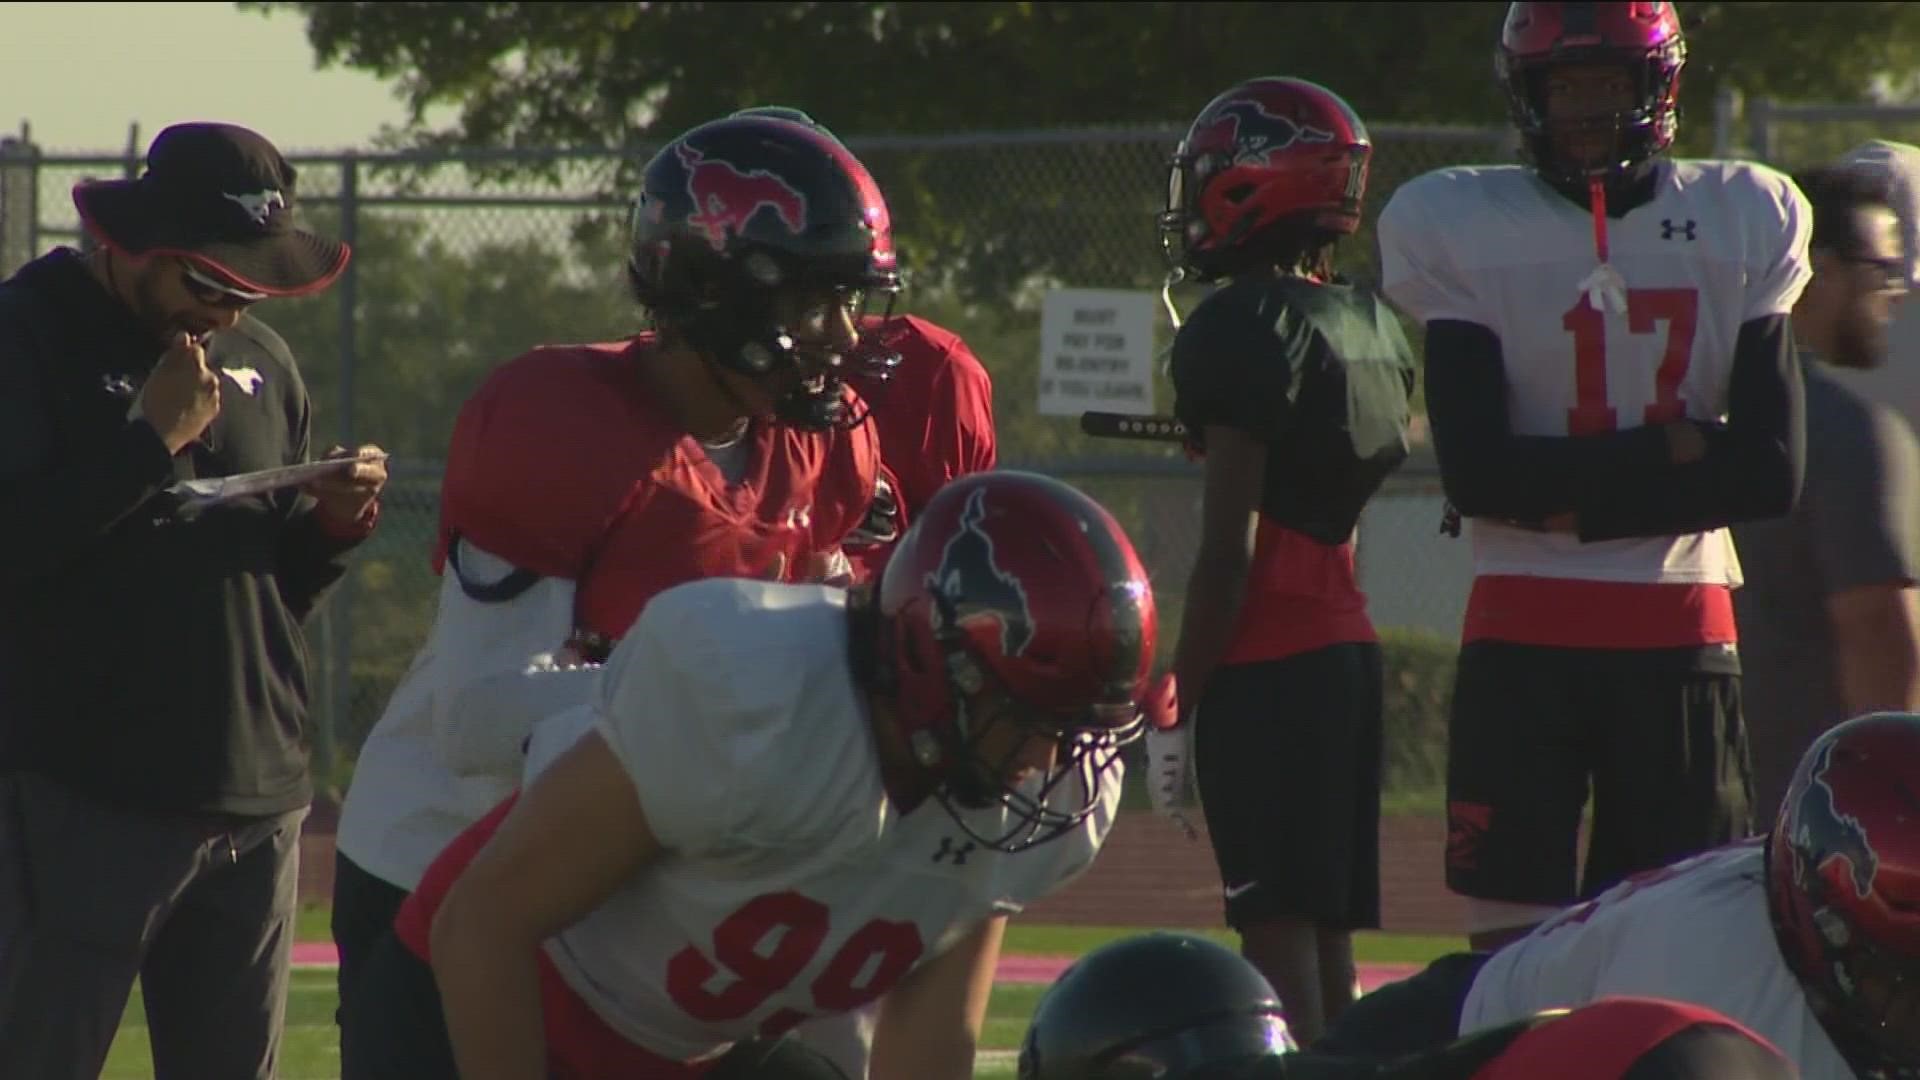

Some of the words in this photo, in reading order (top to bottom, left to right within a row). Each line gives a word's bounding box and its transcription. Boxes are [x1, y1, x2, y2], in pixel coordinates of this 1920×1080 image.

[1063, 333, 1088, 348] PAY
[1094, 334, 1125, 349] FOR
[1563, 287, 1698, 437] 17
